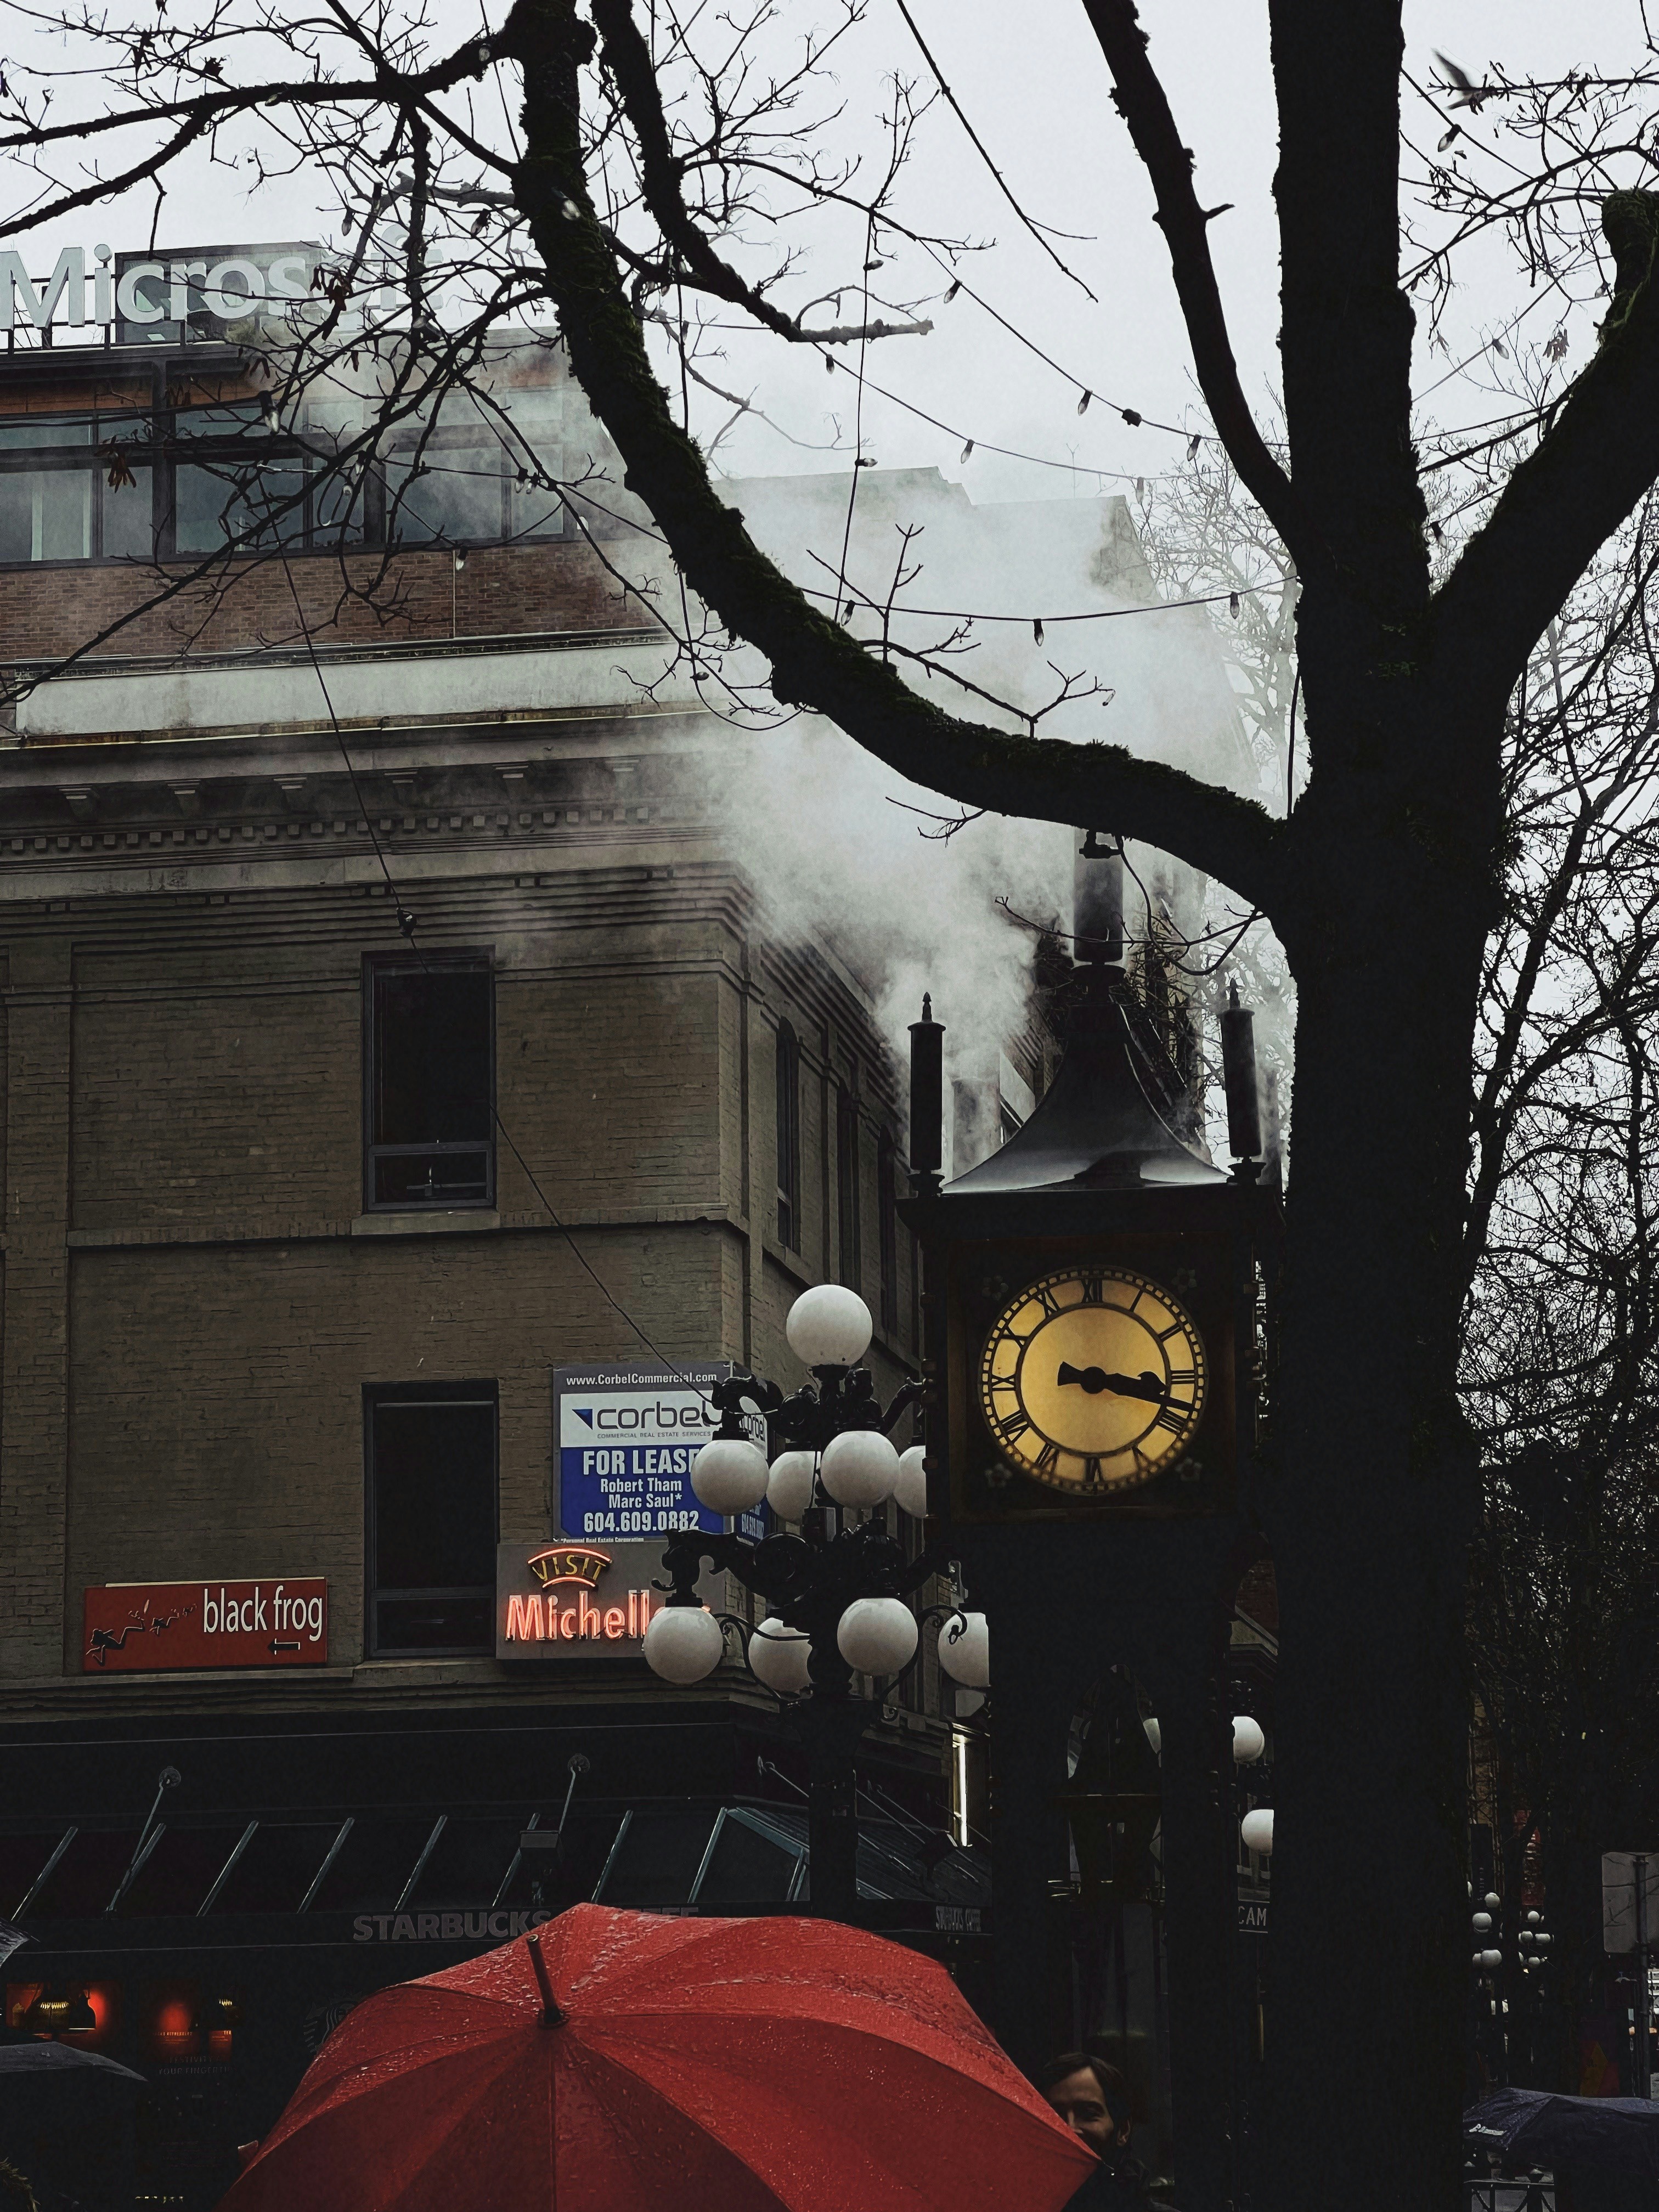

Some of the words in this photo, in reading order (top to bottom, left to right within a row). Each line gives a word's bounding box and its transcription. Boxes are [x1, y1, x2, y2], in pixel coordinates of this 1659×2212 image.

[566, 1372, 718, 1386] www.CorbelCommercial.com
[583, 1450, 625, 1476] FOR
[633, 1448, 700, 1475] LEASE
[600, 1478, 644, 1493] Robert
[647, 1477, 682, 1492] Tham
[608, 1494, 641, 1509] Marc
[584, 1510, 699, 1533] 604.609.0882
[532, 1554, 607, 1582] VISIT
[203, 1587, 268, 1633] black
[273, 1584, 323, 1641] frog
[352, 1910, 552, 1941] STARBUCKS
